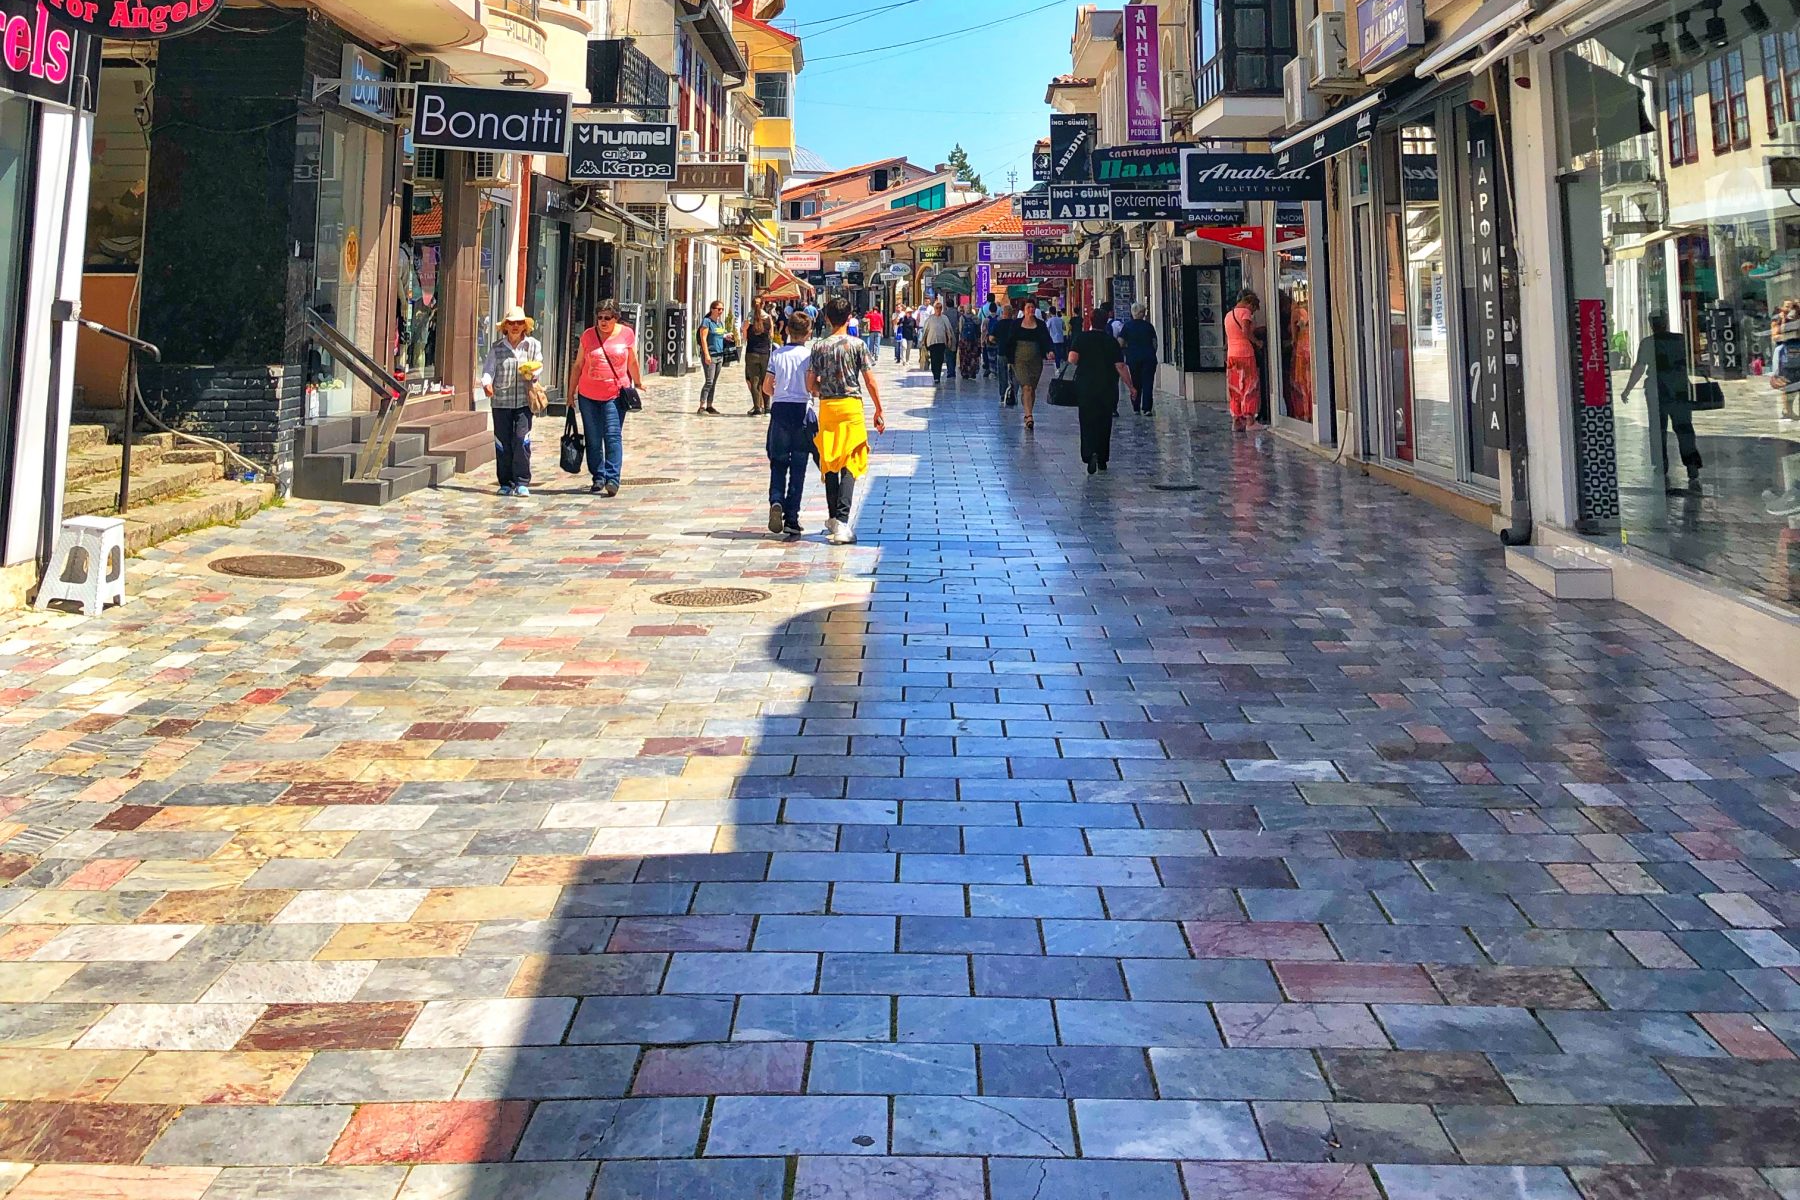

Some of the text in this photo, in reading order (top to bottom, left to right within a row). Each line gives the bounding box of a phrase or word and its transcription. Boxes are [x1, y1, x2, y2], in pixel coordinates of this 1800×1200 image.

[0, 0, 71, 84] els
[420, 94, 563, 144] Bonatti
[592, 126, 671, 146] hummel
[603, 161, 671, 177] Kappa
[1098, 159, 1180, 180] Палм
[1080, 187, 1109, 198] GÜMÜ
[1114, 193, 1183, 207] extreme int
[1188, 214, 1239, 222] BANKOMAT
[1476, 140, 1500, 431] ПАРФИМЕРИЈА
[667, 315, 677, 365] LOOK
[1586, 307, 1602, 372] Ipanema
